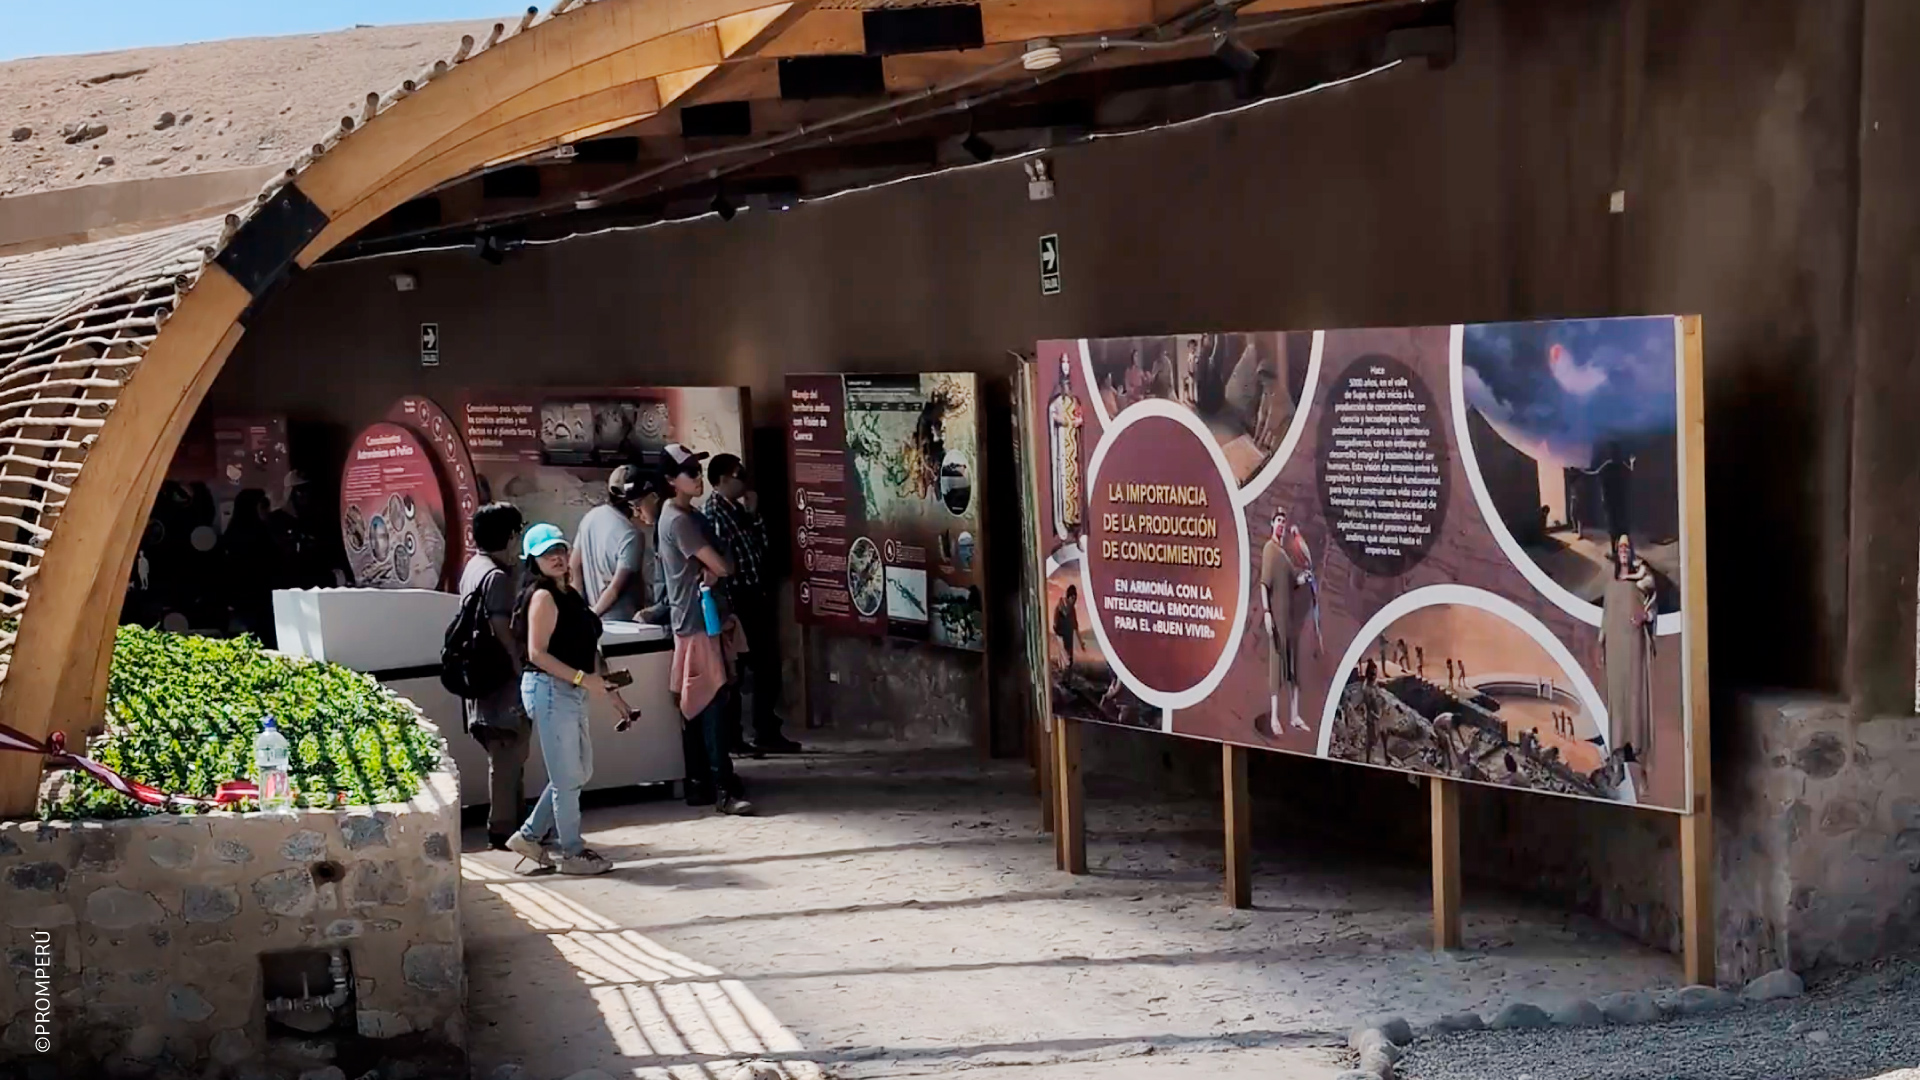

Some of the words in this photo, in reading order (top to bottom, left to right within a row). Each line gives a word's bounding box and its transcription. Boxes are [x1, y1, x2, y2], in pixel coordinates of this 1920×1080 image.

[1370, 366, 1385, 375] Hace
[1379, 379, 1387, 387] en
[1388, 377, 1393, 387] el
[1394, 377, 1408, 387] valle
[1344, 390, 1352, 399] de
[1387, 389, 1402, 399] inicio
[1408, 389, 1414, 399] la
[1335, 403, 1366, 413] producción
[1366, 402, 1374, 411] de
[820, 416, 827, 427] de
[1340, 414, 1360, 423] ciencia
[1360, 416, 1364, 425] y
[1365, 414, 1397, 426] tecnologías
[1398, 416, 1410, 426] que
[1410, 414, 1420, 423] los
[793, 430, 813, 441] Cuenca
[1332, 426, 1363, 436] pobladores
[1364, 426, 1390, 437] aplicaron
[1396, 428, 1402, 436] su
[1404, 427, 1430, 436] territorio
[1394, 439, 1417, 450] enfoque
[1418, 439, 1426, 448] de
[1329, 450, 1356, 459] desarrollo
[1358, 450, 1379, 461] integral
[1380, 452, 1384, 462] y
[1385, 450, 1413, 460] sostenible
[1414, 451, 1424, 460] del
[1352, 462, 1363, 471] Esta
[1364, 462, 1380, 471] visión
[1382, 463, 1390, 472] de
[1391, 463, 1414, 472] armonía
[1415, 464, 1430, 473] entre
[1325, 473, 1351, 484] cognitivo
[1351, 476, 1355, 484] y
[1356, 474, 1362, 483] lo
[1363, 475, 1392, 483] emocional
[1393, 475, 1402, 484] fue
[1404, 475, 1441, 485] fundamental
[1108, 484, 1123, 502] LA
[1126, 484, 1208, 506] IMPORTANCIA
[1329, 487, 1342, 495] para
[1342, 485, 1359, 496] lograr
[1360, 486, 1385, 495] construir
[1398, 486, 1410, 496] vida
[1411, 487, 1428, 497] social
[1428, 487, 1437, 497] de
[1330, 496, 1355, 506] bienestar
[1395, 499, 1400, 508] la
[1402, 500, 1427, 509] sociedad
[1428, 500, 1436, 510] de
[1364, 509, 1372, 519] Su
[1412, 511, 1422, 522] fue
[1103, 513, 1119, 531] DE
[1122, 514, 1136, 532] LA
[1139, 514, 1216, 537] PRODUCCIÓN
[1337, 520, 1369, 531] significativa
[1378, 521, 1384, 531] el
[1384, 524, 1407, 533] proceso
[1408, 523, 1431, 533] cultural
[1367, 536, 1378, 544] que
[1399, 535, 1415, 545] hasta
[1416, 536, 1422, 545] el
[1102, 541, 1118, 559] DE
[1121, 542, 1221, 566] CONOCIMIENTOS
[1365, 545, 1387, 556] imperio
[1115, 579, 1128, 592] EN
[1129, 579, 1174, 597] ARMONÍA
[1176, 584, 1198, 599] CON
[1200, 586, 1213, 600] LA
[1104, 596, 1166, 615] INTELIGENCIA
[1168, 602, 1225, 620] EMOCIONAL
[1114, 616, 1138, 631] PARA
[1140, 618, 1150, 632] EL
[1152, 620, 1183, 636] «BUEN
[1184, 622, 1215, 639] VIVIR»
